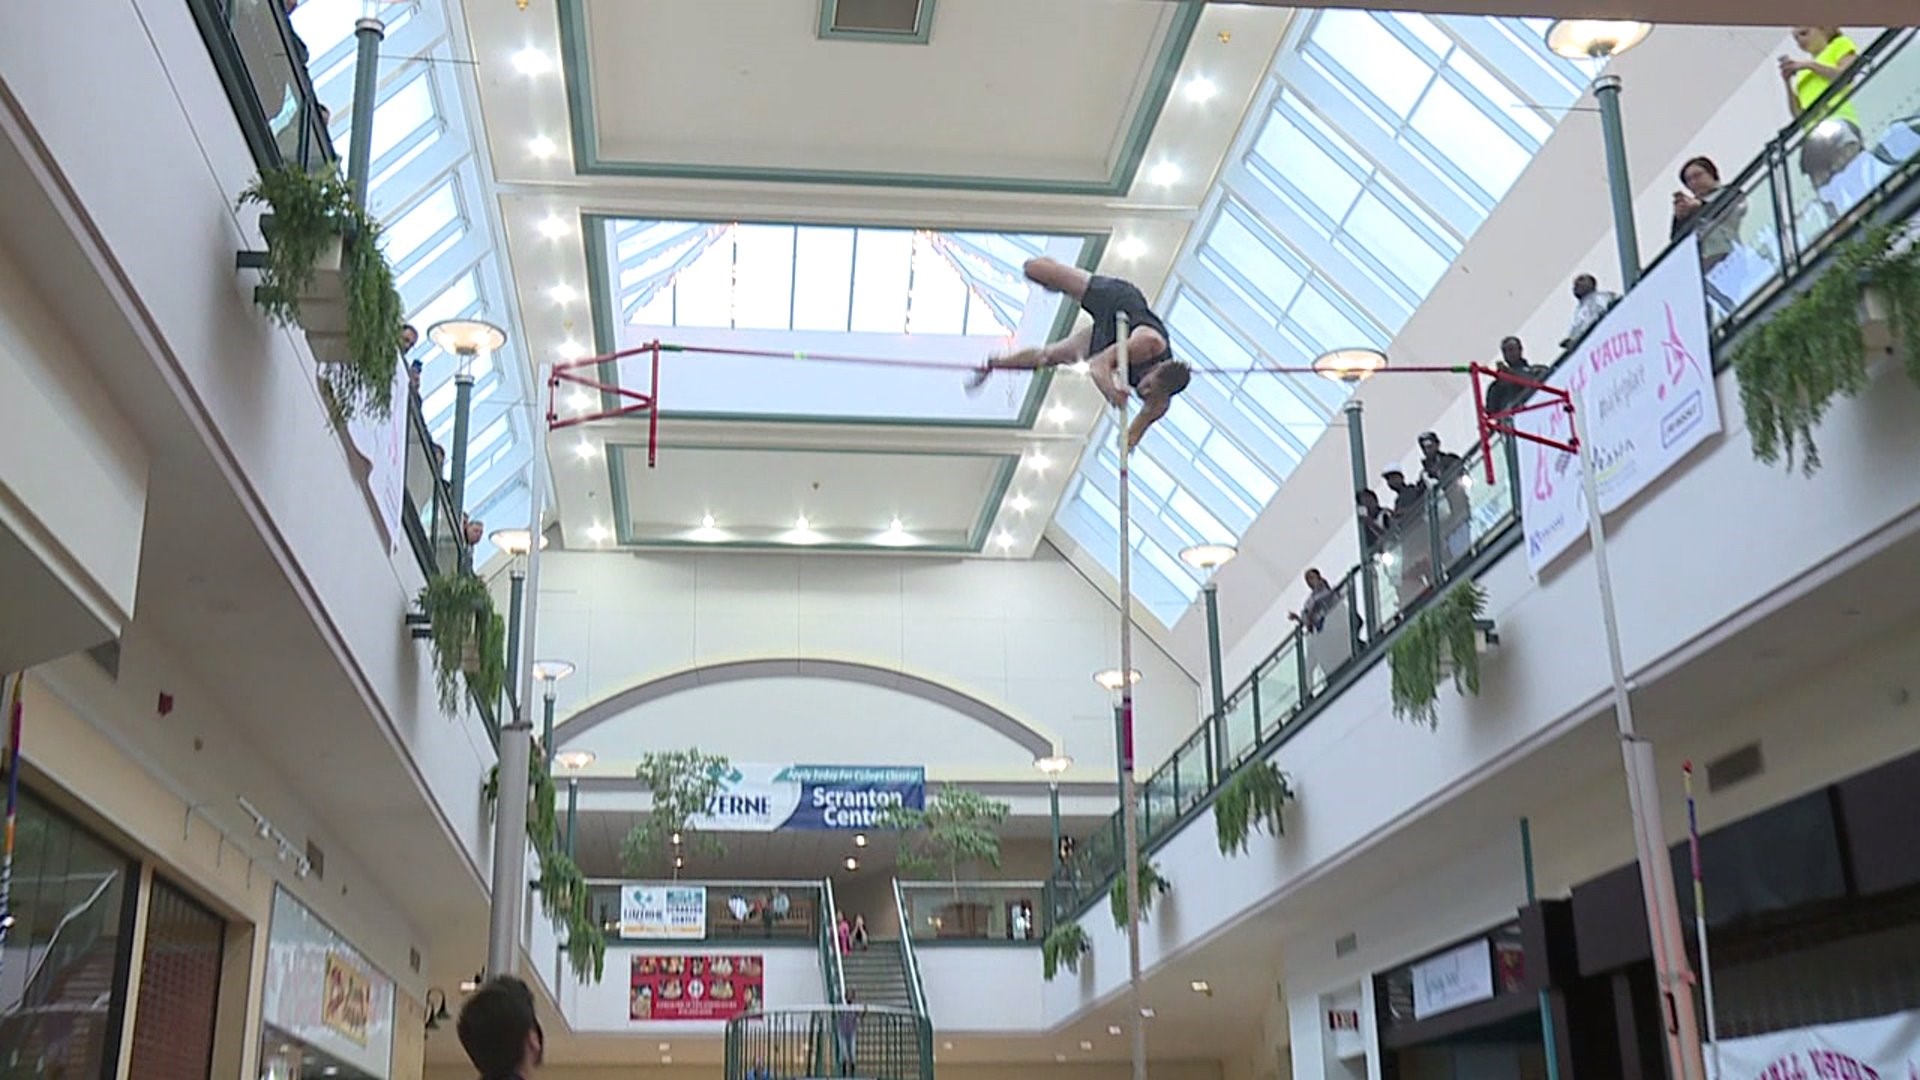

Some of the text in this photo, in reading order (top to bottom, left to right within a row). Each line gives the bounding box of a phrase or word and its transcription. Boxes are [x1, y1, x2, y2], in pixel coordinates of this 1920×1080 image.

[1590, 328, 1644, 373] VAULT
[699, 795, 770, 815] ZERNE
[813, 787, 902, 808] Scranton
[824, 806, 889, 827] Cente
